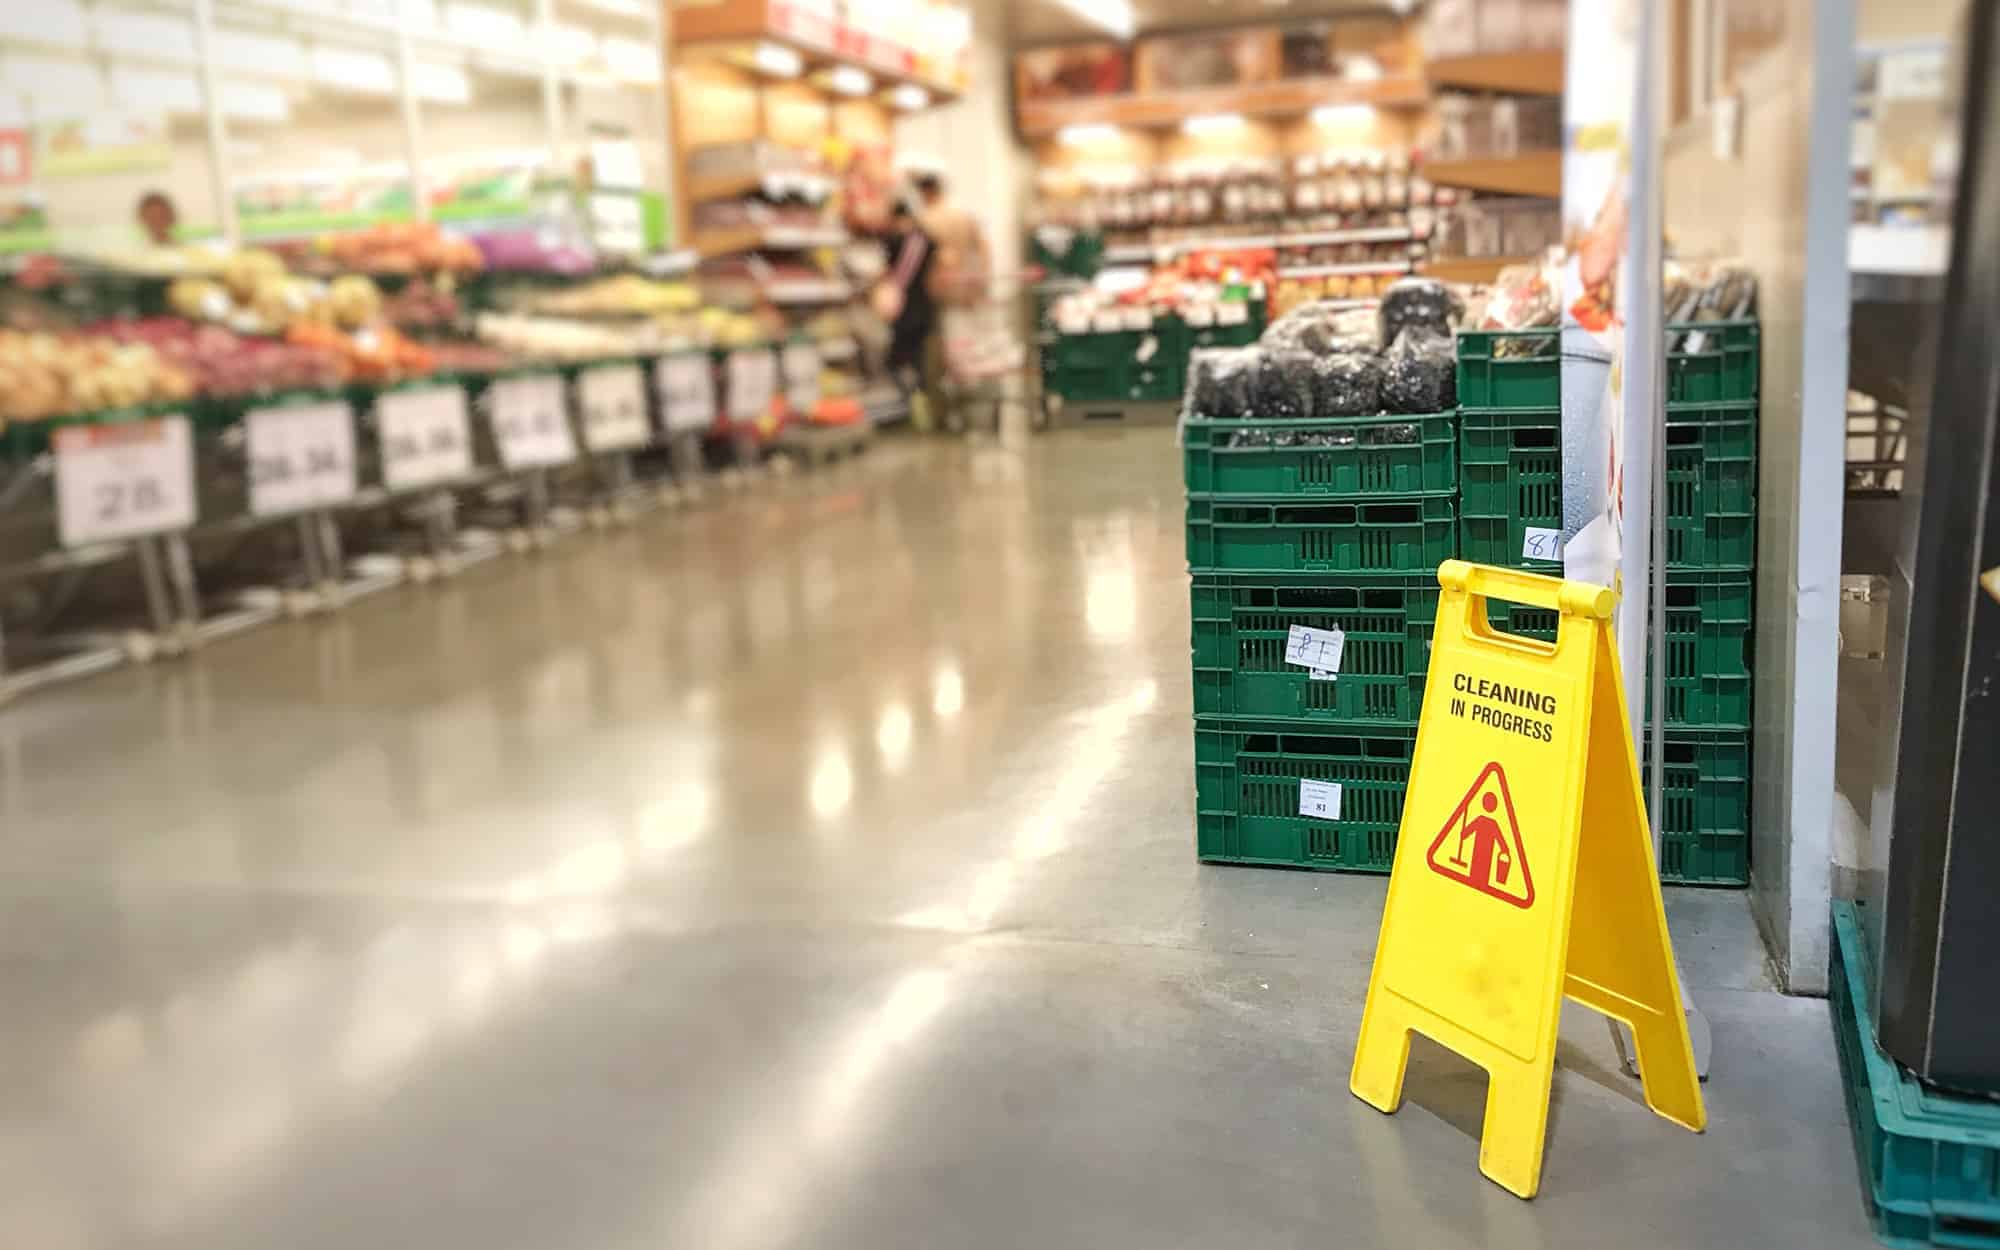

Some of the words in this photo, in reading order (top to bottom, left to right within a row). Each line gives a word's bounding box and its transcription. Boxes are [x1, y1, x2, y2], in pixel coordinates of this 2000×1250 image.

[1528, 534, 1559, 560] 81
[1454, 673, 1556, 716] CLEANING
[1450, 698, 1466, 719] IN
[1472, 704, 1553, 743] PROGRESS
